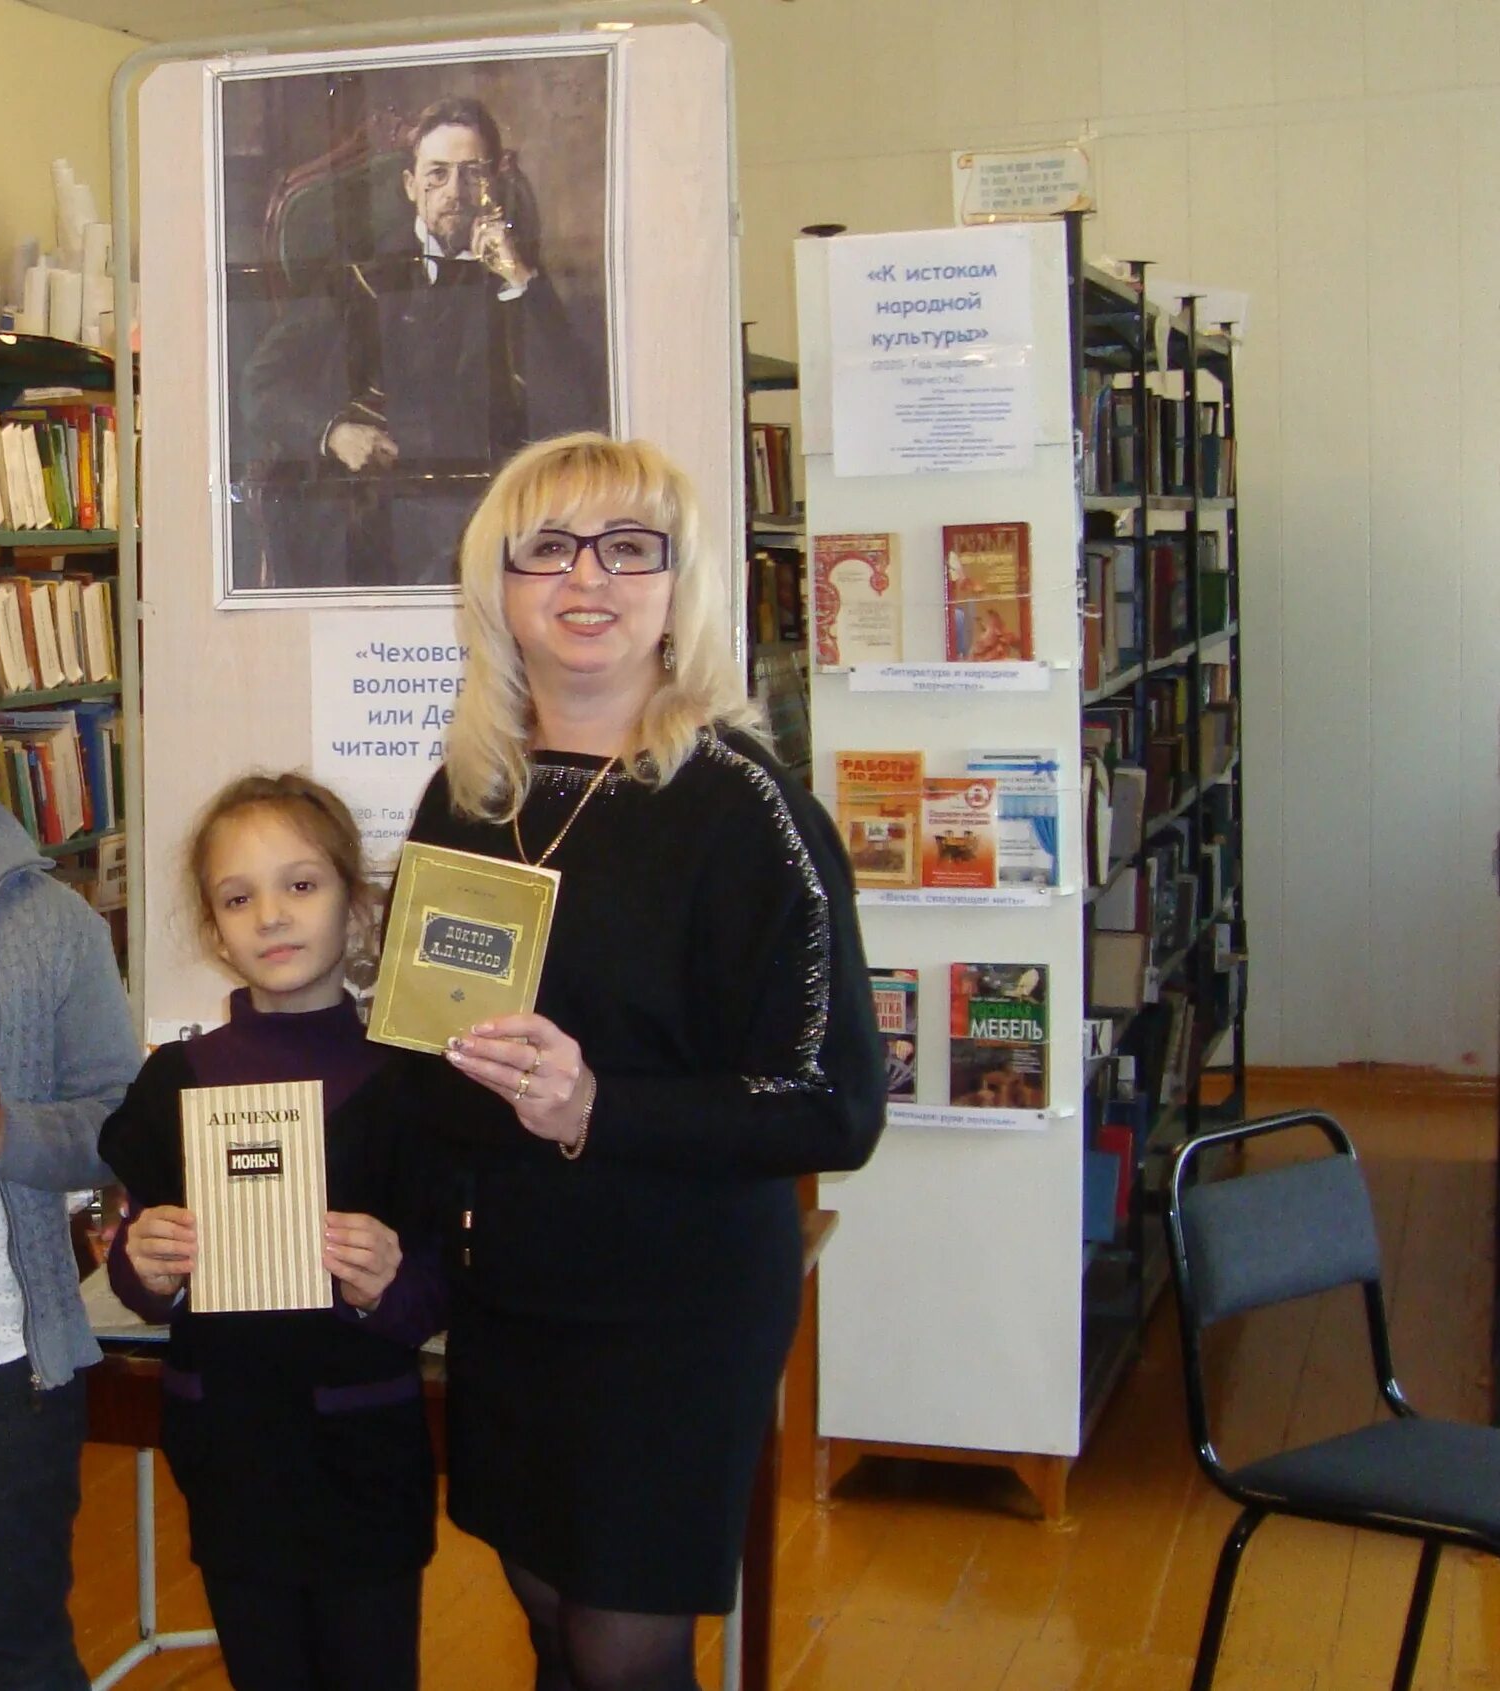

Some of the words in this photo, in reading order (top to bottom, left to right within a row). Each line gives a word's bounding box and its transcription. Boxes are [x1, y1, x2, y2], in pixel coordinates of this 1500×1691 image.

[867, 265, 896, 281] «К
[905, 263, 997, 281] истокам
[876, 291, 981, 318] народной
[871, 328, 989, 350] культуры»
[356, 642, 470, 662] «Чеховск
[353, 678, 466, 700] волонтер
[369, 709, 413, 725] или
[422, 705, 455, 729] Де
[332, 740, 419, 756] читают
[381, 808, 404, 820] Год
[446, 925, 494, 947] ДОКТОР
[970, 1017, 1043, 1040] МЕБЕЛЬ
[240, 1108, 300, 1125] ЧЕХОВ
[231, 1153, 279, 1169] ИОНЫЧ
